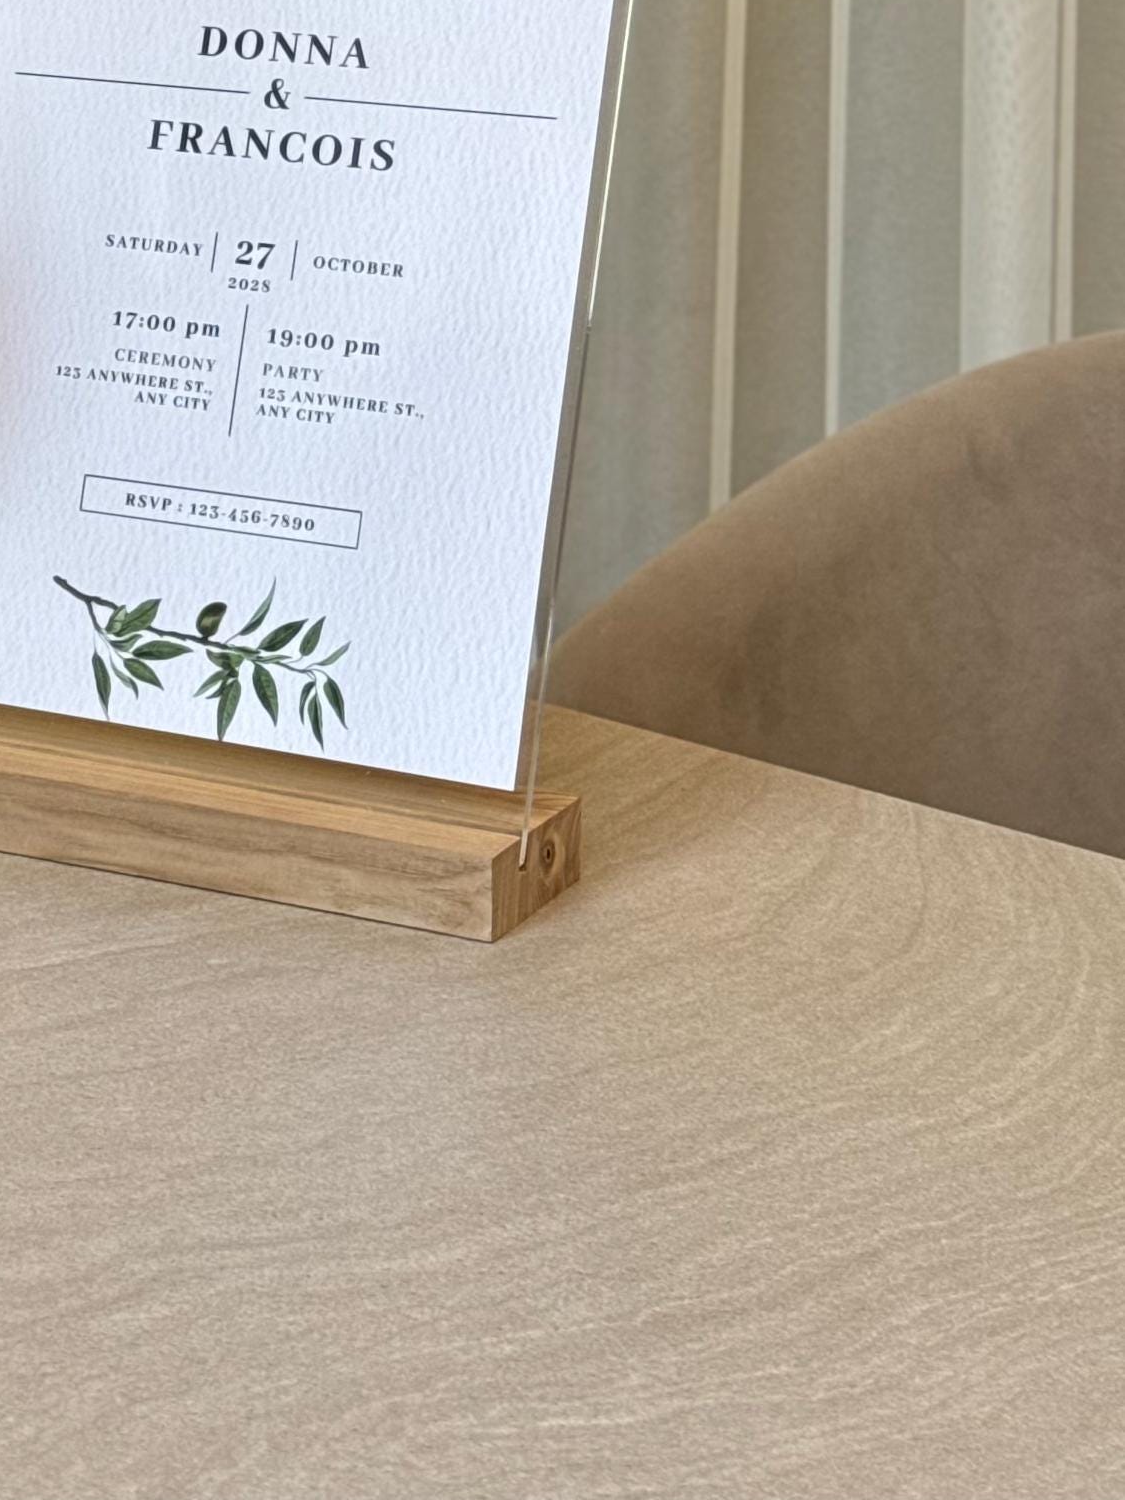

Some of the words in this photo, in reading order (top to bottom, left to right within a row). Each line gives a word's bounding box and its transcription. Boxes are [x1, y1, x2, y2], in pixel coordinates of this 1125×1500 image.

[197, 25, 370, 69] DONNA
[263, 77, 291, 110] &
[146, 118, 396, 172] FRANCOIS
[105, 234, 204, 257] SATURDAY
[234, 240, 276, 270] 27
[313, 255, 405, 278] OCTOBER
[227, 277, 272, 293] 2028
[112, 310, 176, 332] 17:00
[185, 320, 221, 339] pm
[267, 328, 335, 350] 19:00
[343, 339, 381, 357] pm
[114, 348, 217, 372] CEREMONY
[262, 363, 324, 382] PARTY
[55, 365, 82, 379] 123
[86, 368, 179, 390] ANYWHERE
[183, 379, 213, 396] ST.,
[134, 391, 168, 406] ANY
[172, 395, 211, 412] CITY
[255, 404, 291, 419] ANY
[295, 408, 336, 425] CITY
[258, 387, 286, 402] 123
[291, 390, 389, 414] ANYWHERE
[394, 402, 425, 419] ST.,
[125, 492, 173, 512] RSVP
[189, 502, 316, 532] 123-456-7890
